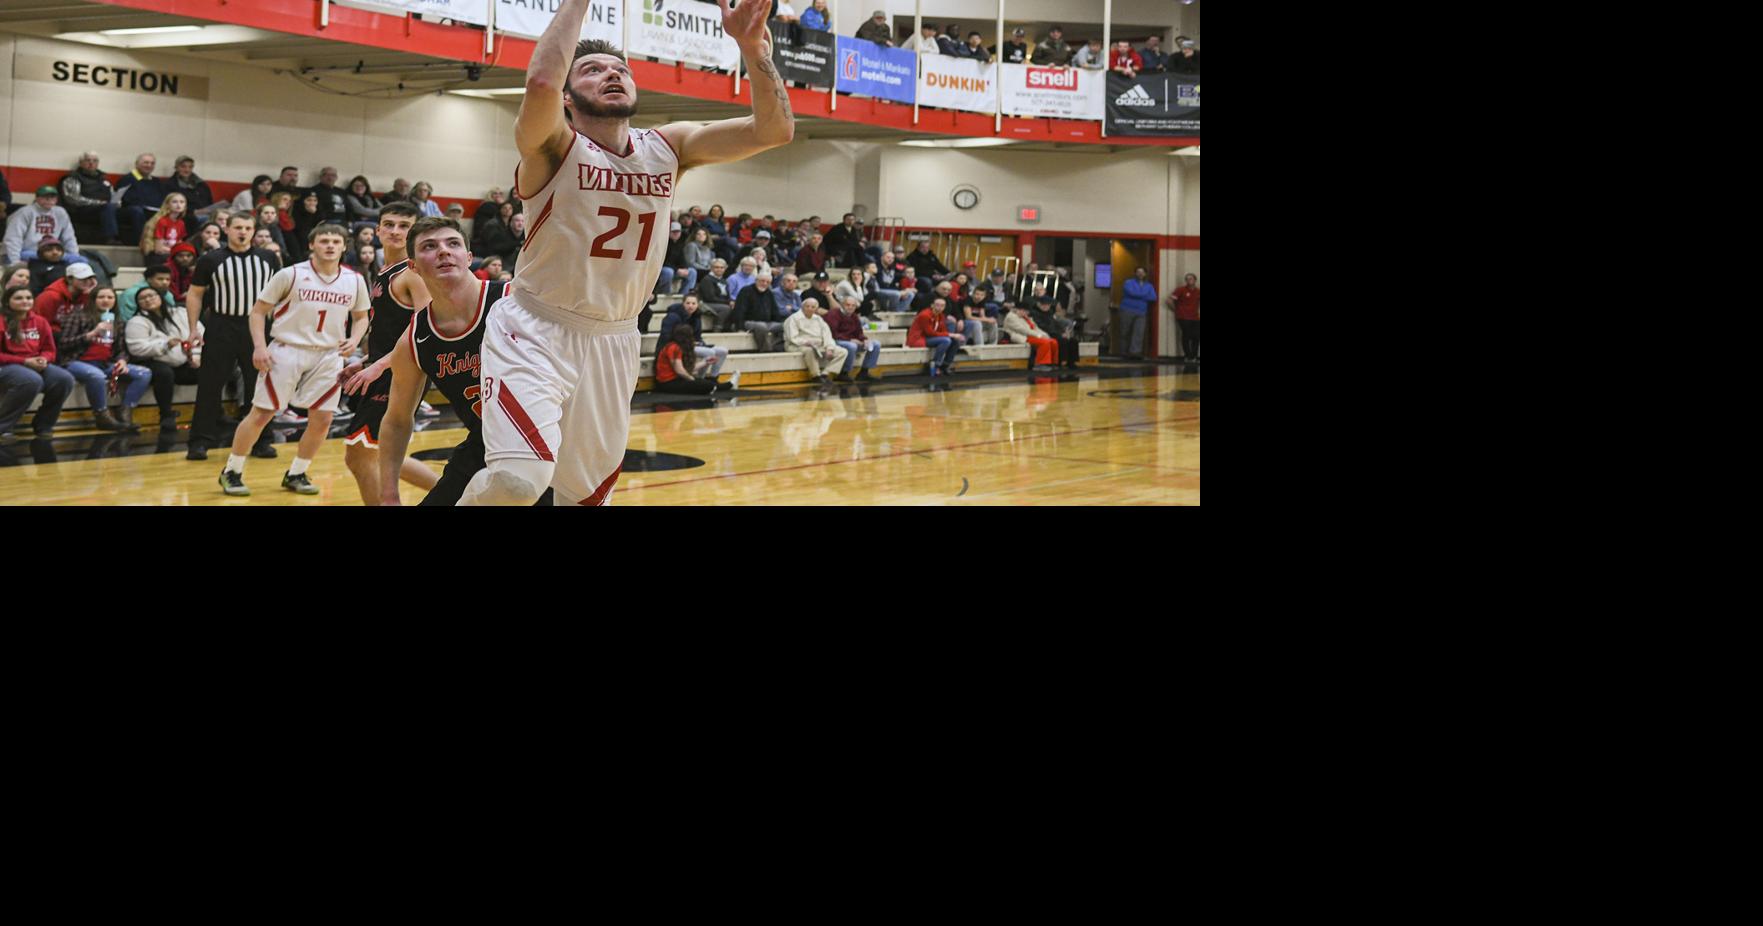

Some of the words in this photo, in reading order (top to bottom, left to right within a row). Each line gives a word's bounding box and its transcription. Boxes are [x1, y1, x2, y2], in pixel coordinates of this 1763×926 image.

[666, 10, 723, 38] SMITH
[52, 61, 178, 95] SECTION
[926, 72, 990, 92] DUNKIN'
[1029, 69, 1074, 87] snell
[1115, 98, 1155, 106] adidas
[589, 206, 656, 260] 21
[298, 289, 352, 305] VIKINGS
[316, 310, 327, 333] 1
